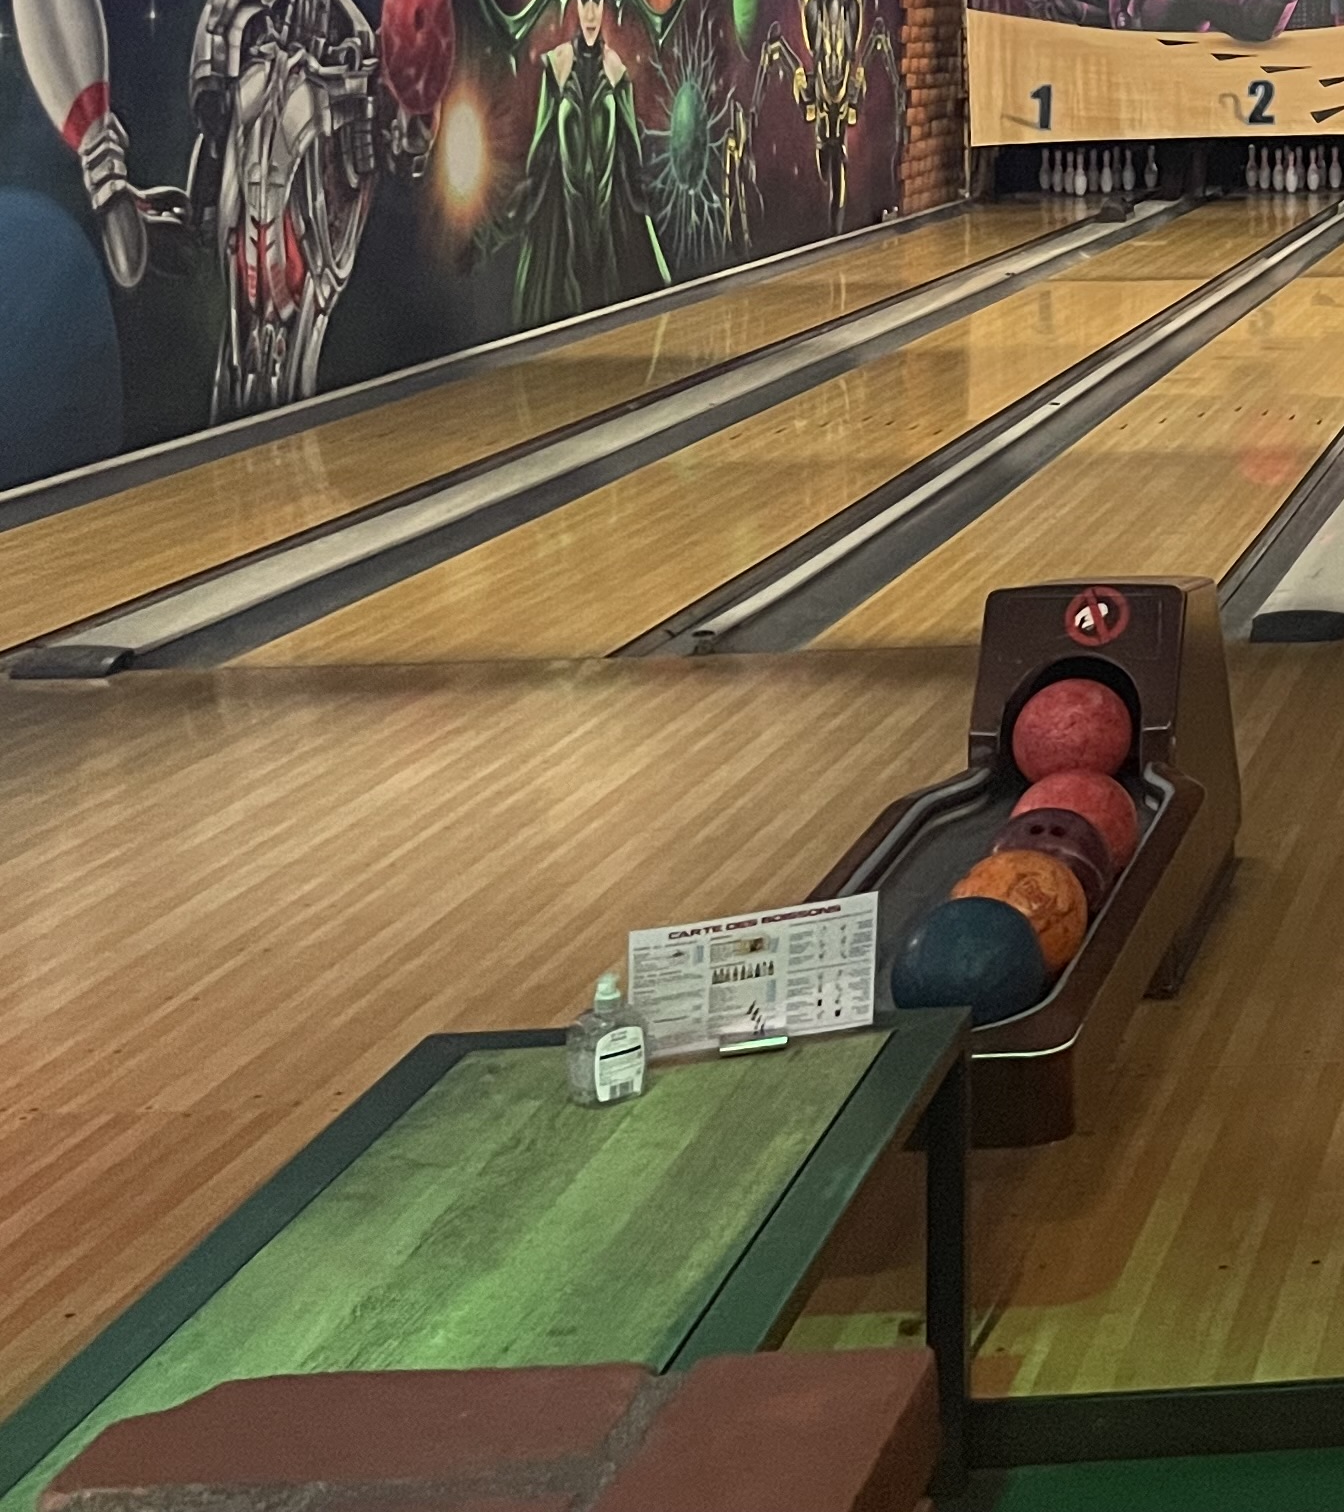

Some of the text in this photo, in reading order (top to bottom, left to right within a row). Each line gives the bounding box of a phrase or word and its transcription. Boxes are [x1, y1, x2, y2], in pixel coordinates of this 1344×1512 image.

[1030, 83, 1053, 131] 1
[1247, 79, 1276, 126] 2
[668, 924, 723, 940] CARTE
[726, 918, 758, 931] DES
